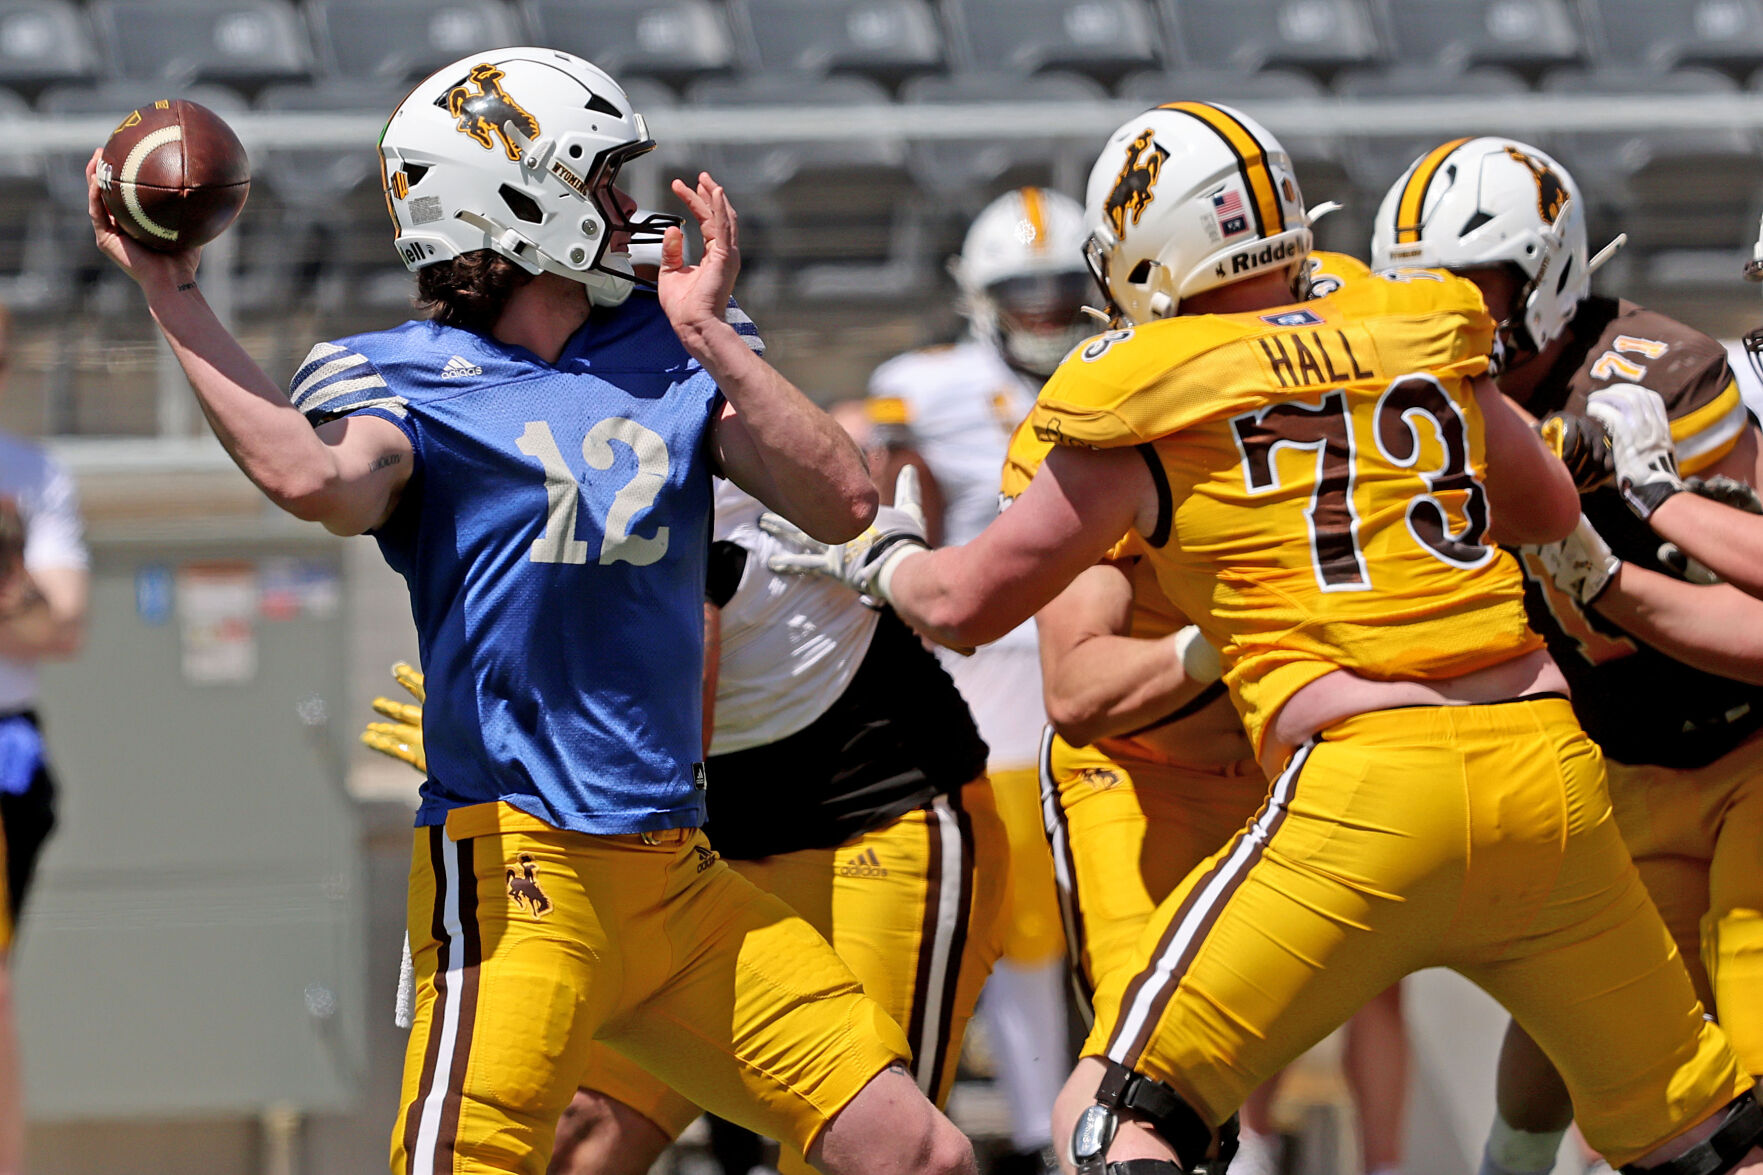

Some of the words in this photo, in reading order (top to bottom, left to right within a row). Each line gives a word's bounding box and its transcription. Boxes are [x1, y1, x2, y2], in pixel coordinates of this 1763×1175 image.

[441, 366, 483, 379] adidas
[1258, 328, 1374, 388] HALL
[1590, 335, 1669, 382] 71
[514, 416, 670, 566] 12
[1229, 372, 1494, 593] 73
[840, 865, 889, 878] adidas
